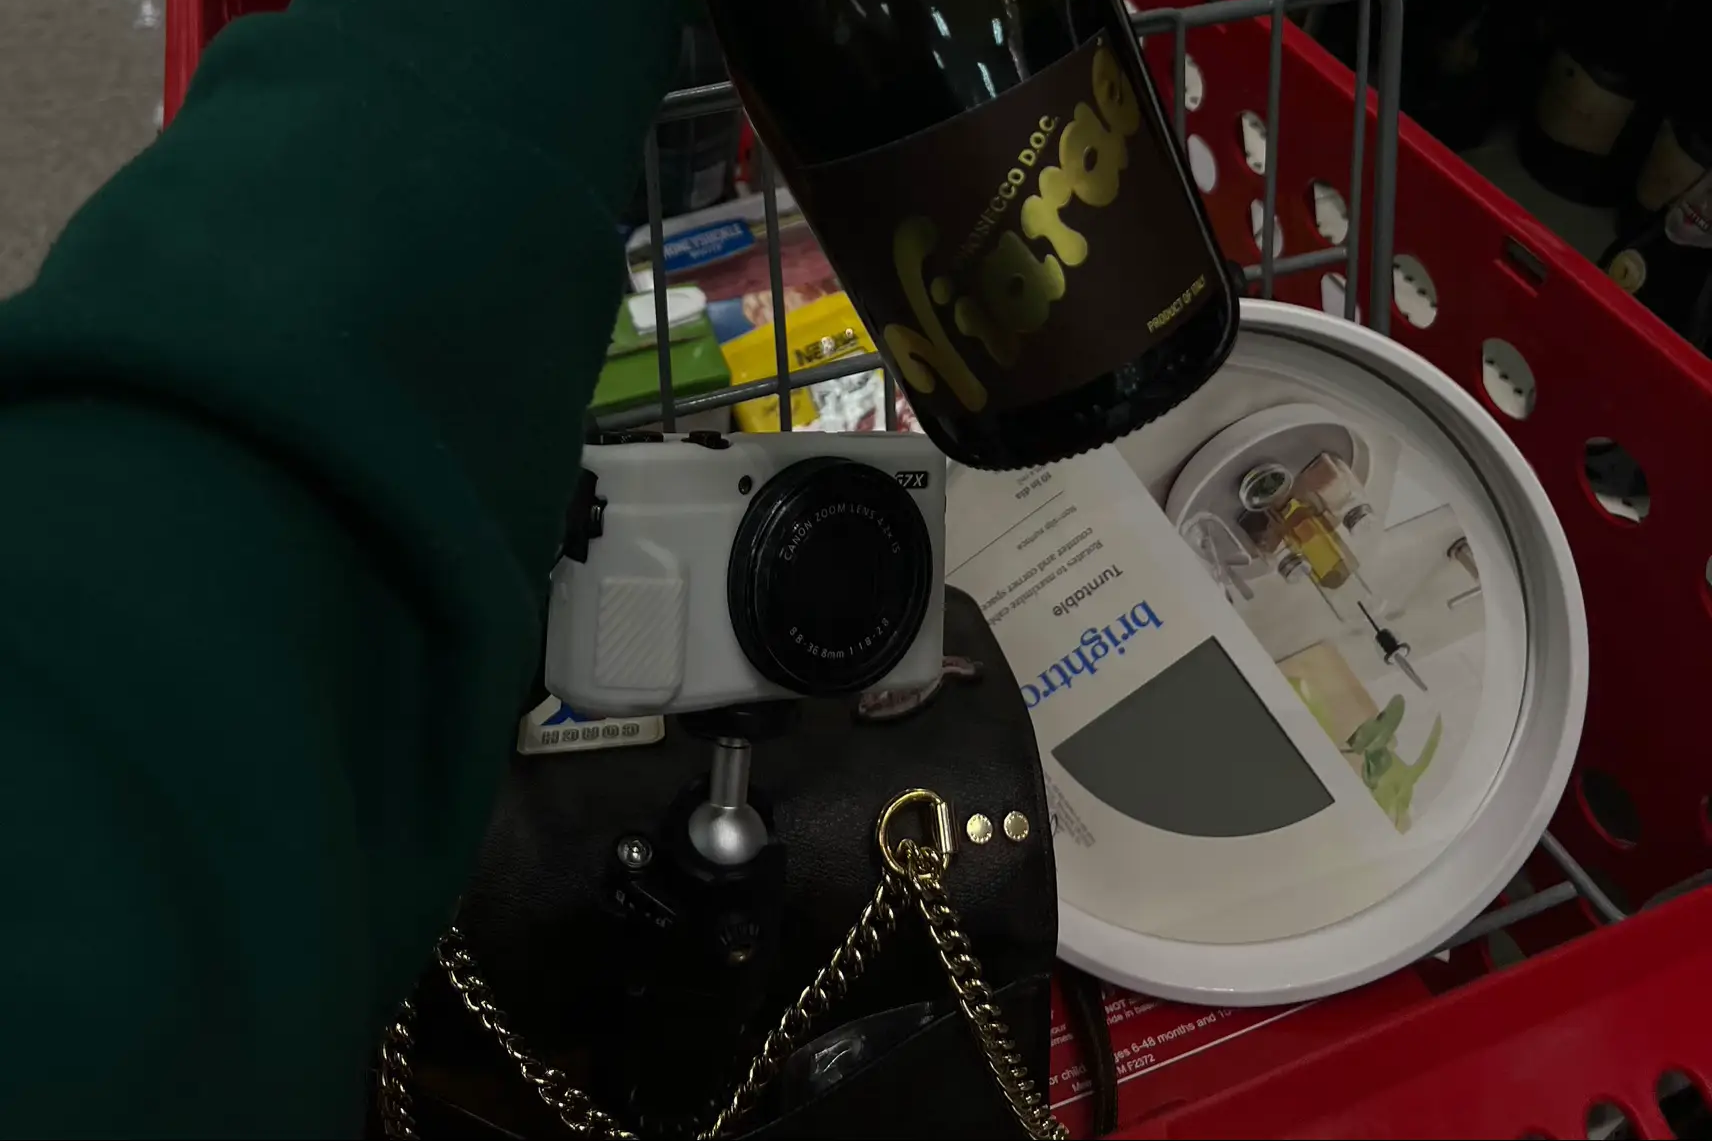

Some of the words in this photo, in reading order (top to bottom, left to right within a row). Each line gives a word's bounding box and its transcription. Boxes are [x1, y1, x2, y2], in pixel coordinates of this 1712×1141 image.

[783, 519, 813, 562] CANON
[815, 501, 847, 523] ZOOM
[850, 502, 877, 520] LENS
[1056, 526, 1094, 557] counter
[1037, 553, 1057, 573] and
[1066, 539, 1104, 568] Rotates
[1007, 566, 1039, 593] corner
[1055, 564, 1068, 577] to
[981, 589, 1008, 612] space
[1012, 574, 1056, 610] maximize
[1052, 563, 1124, 617] Turntable
[1019, 599, 1165, 709] brightro
[1104, 998, 1127, 1015] NOT
[1061, 1062, 1088, 1081] child
[1112, 1047, 1131, 1064] ges
[1131, 1035, 1157, 1053] 6-48
[1156, 1022, 1196, 1045] months
[1196, 1011, 1217, 1028] and
